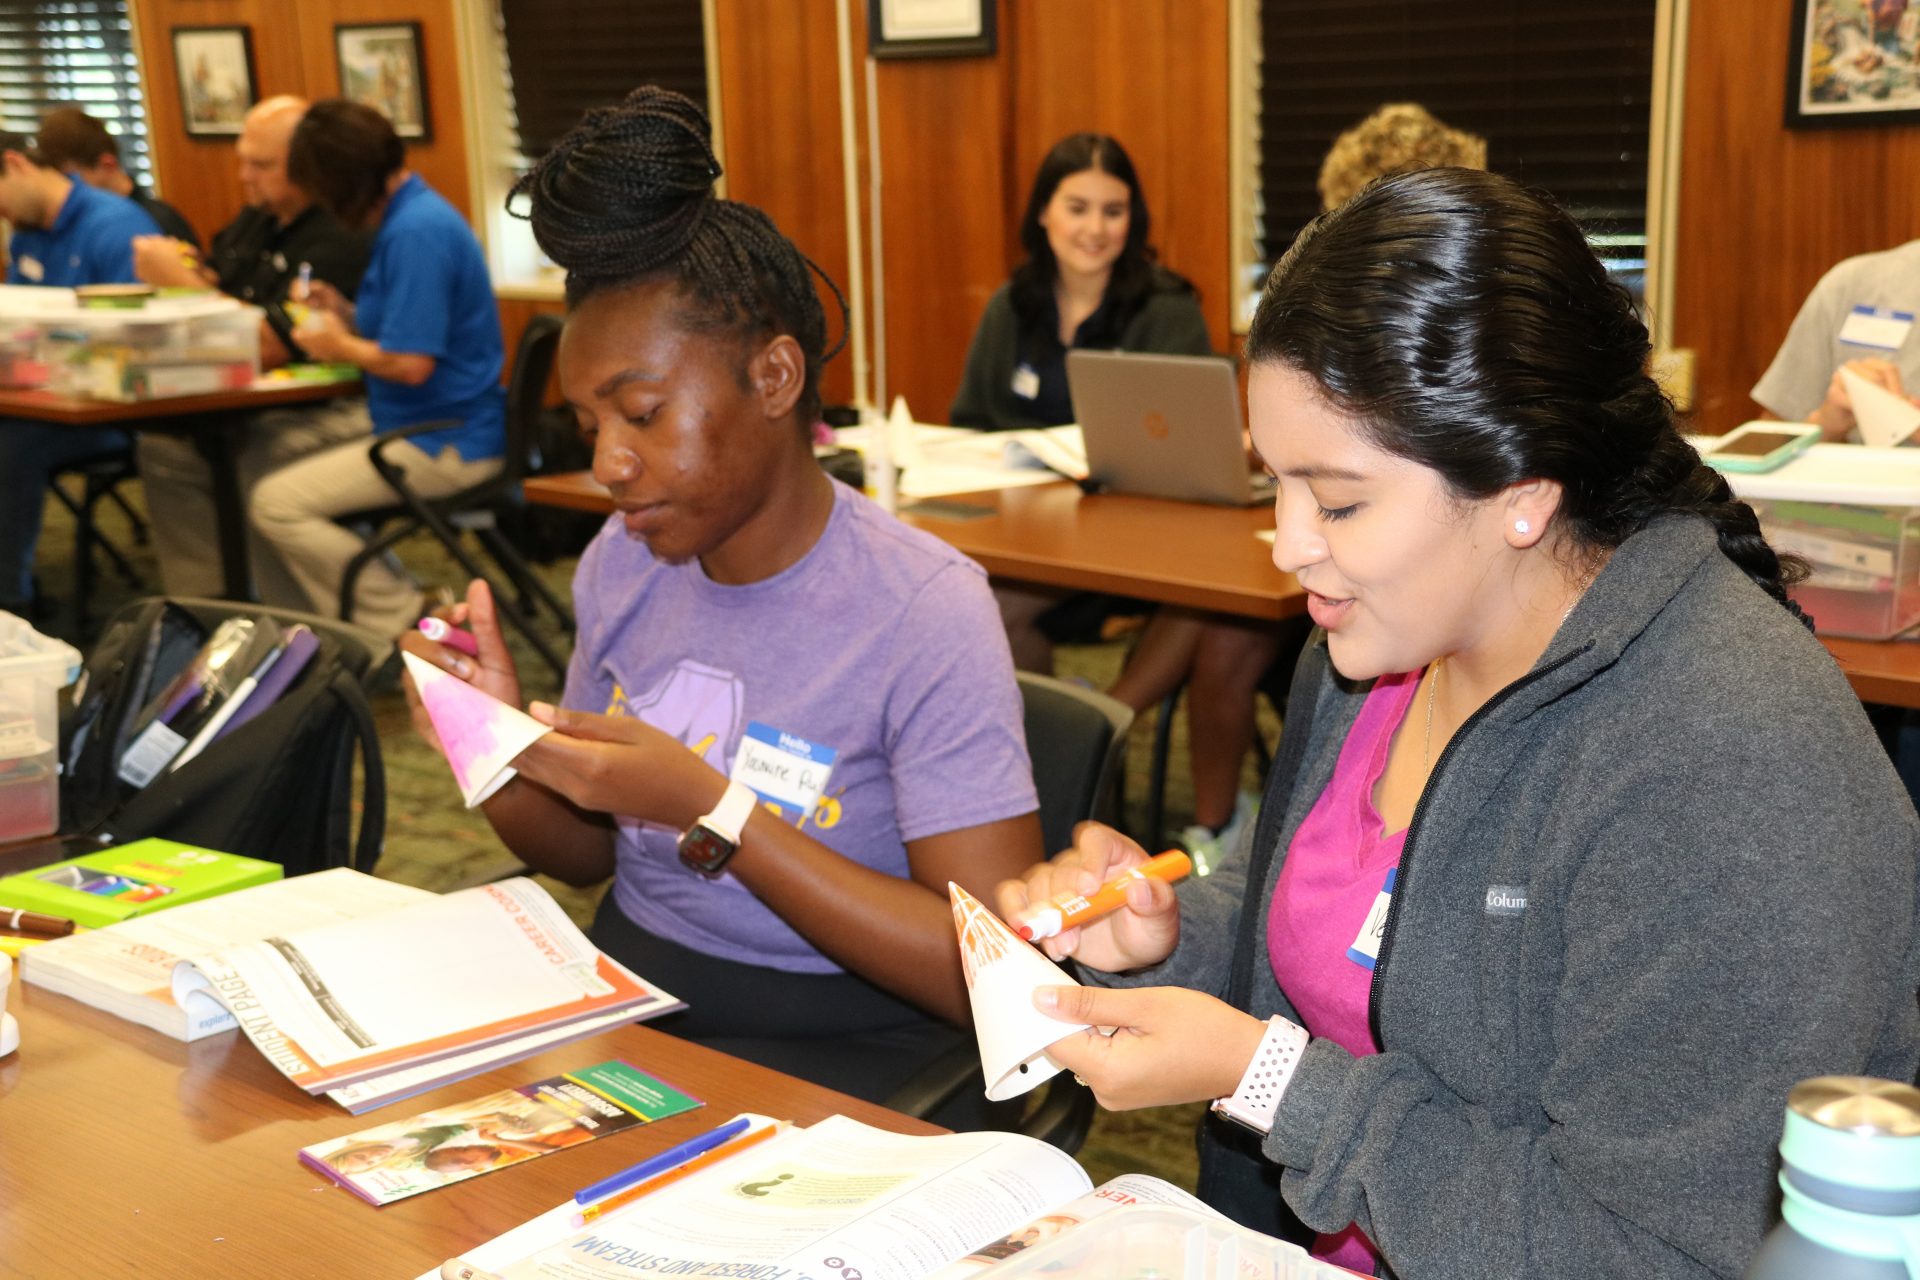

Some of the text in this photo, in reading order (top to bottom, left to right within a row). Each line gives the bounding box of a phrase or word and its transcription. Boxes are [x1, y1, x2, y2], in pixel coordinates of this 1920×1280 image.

[778, 732, 812, 753] Hello
[515, 915, 565, 965] CAREER
[212, 970, 305, 1074] STUDENT PAGE
[571, 1235, 668, 1271] STREAM
[658, 1256, 708, 1276] AND
[700, 1262, 792, 1280] FOREST
